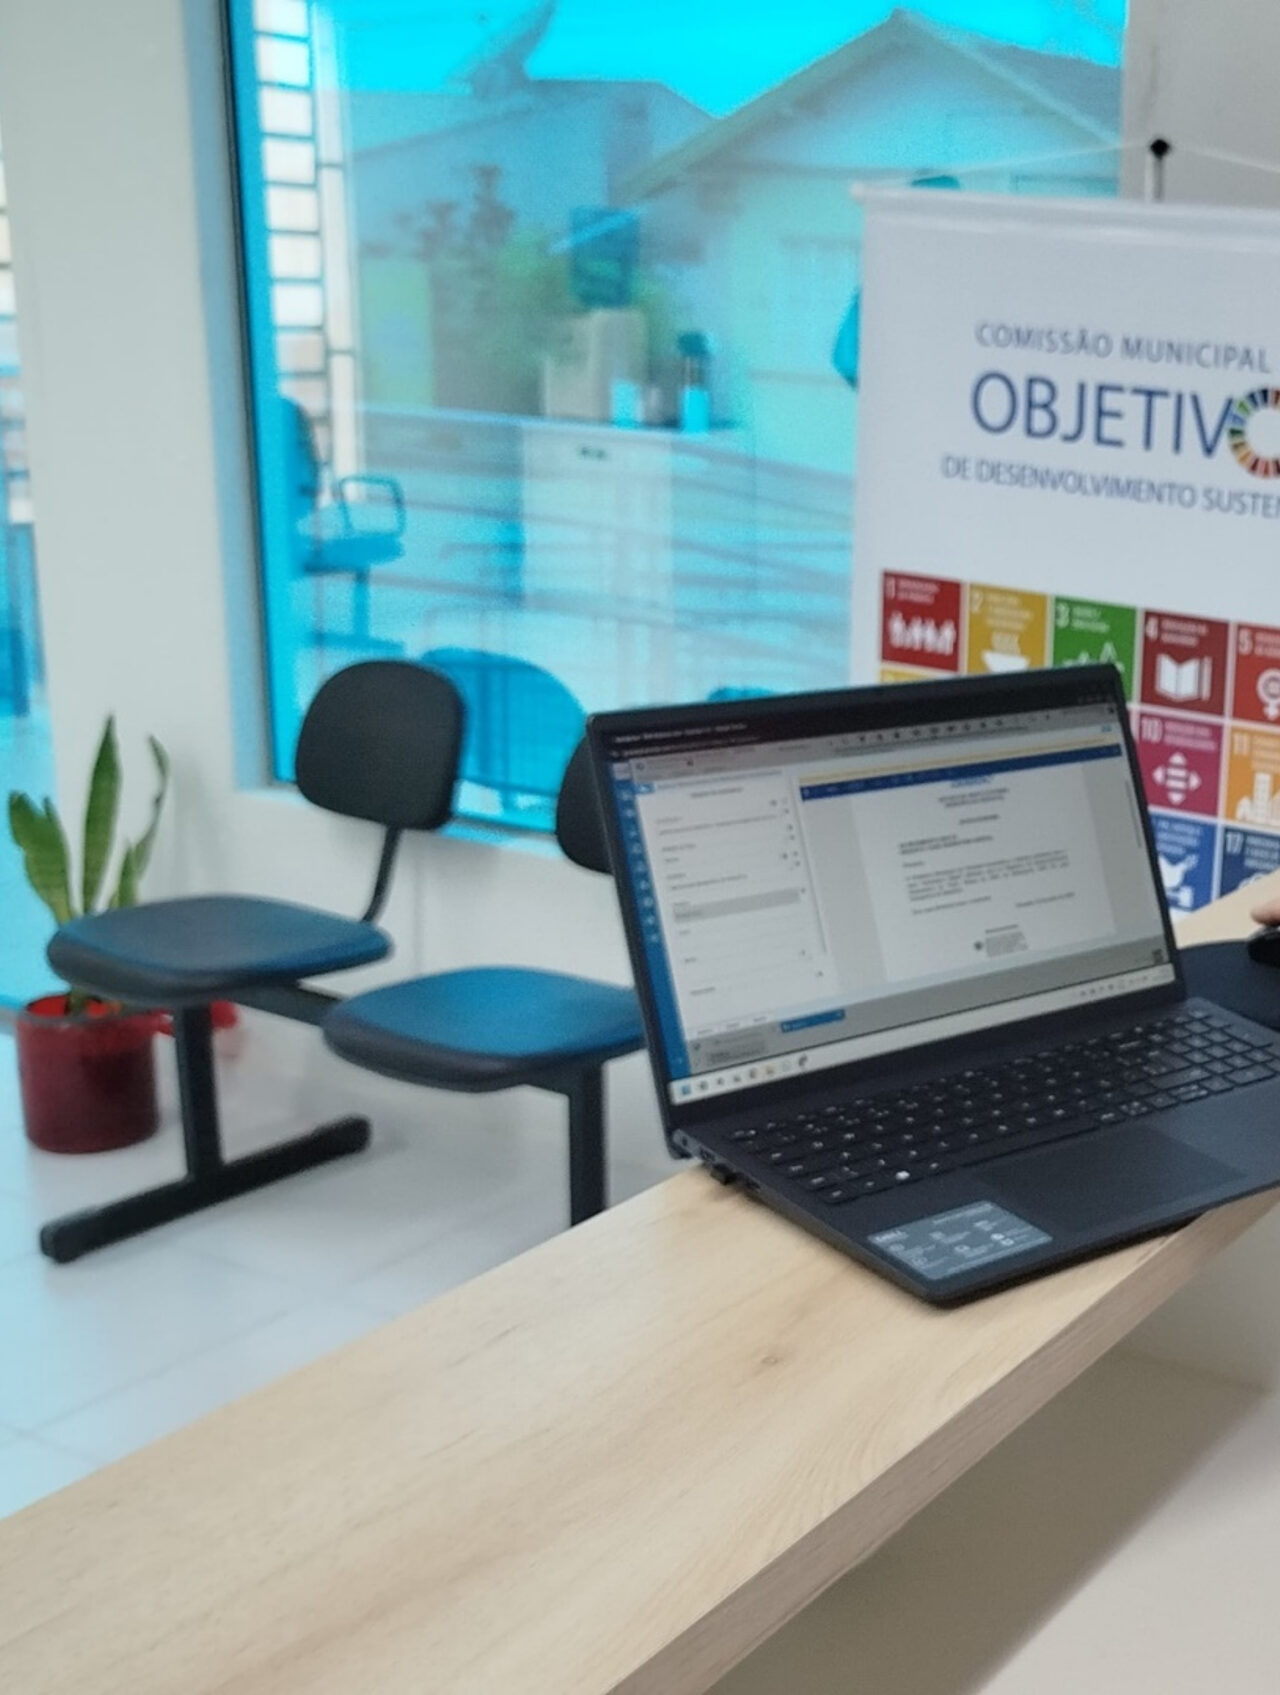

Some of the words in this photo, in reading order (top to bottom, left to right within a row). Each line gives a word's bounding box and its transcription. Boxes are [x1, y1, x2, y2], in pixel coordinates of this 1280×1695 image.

[974, 321, 1113, 359] COMISSÃO
[1120, 335, 1270, 374] MUNICIPAL
[942, 454, 970, 481] DE
[974, 458, 1198, 509] DESENVOLVIMENTO
[1056, 603, 1071, 629] 3
[1145, 616, 1160, 642] 4
[1239, 629, 1253, 655] 5
[1141, 716, 1164, 743] 10
[1232, 732, 1252, 756] 11
[1226, 832, 1244, 855] 17
